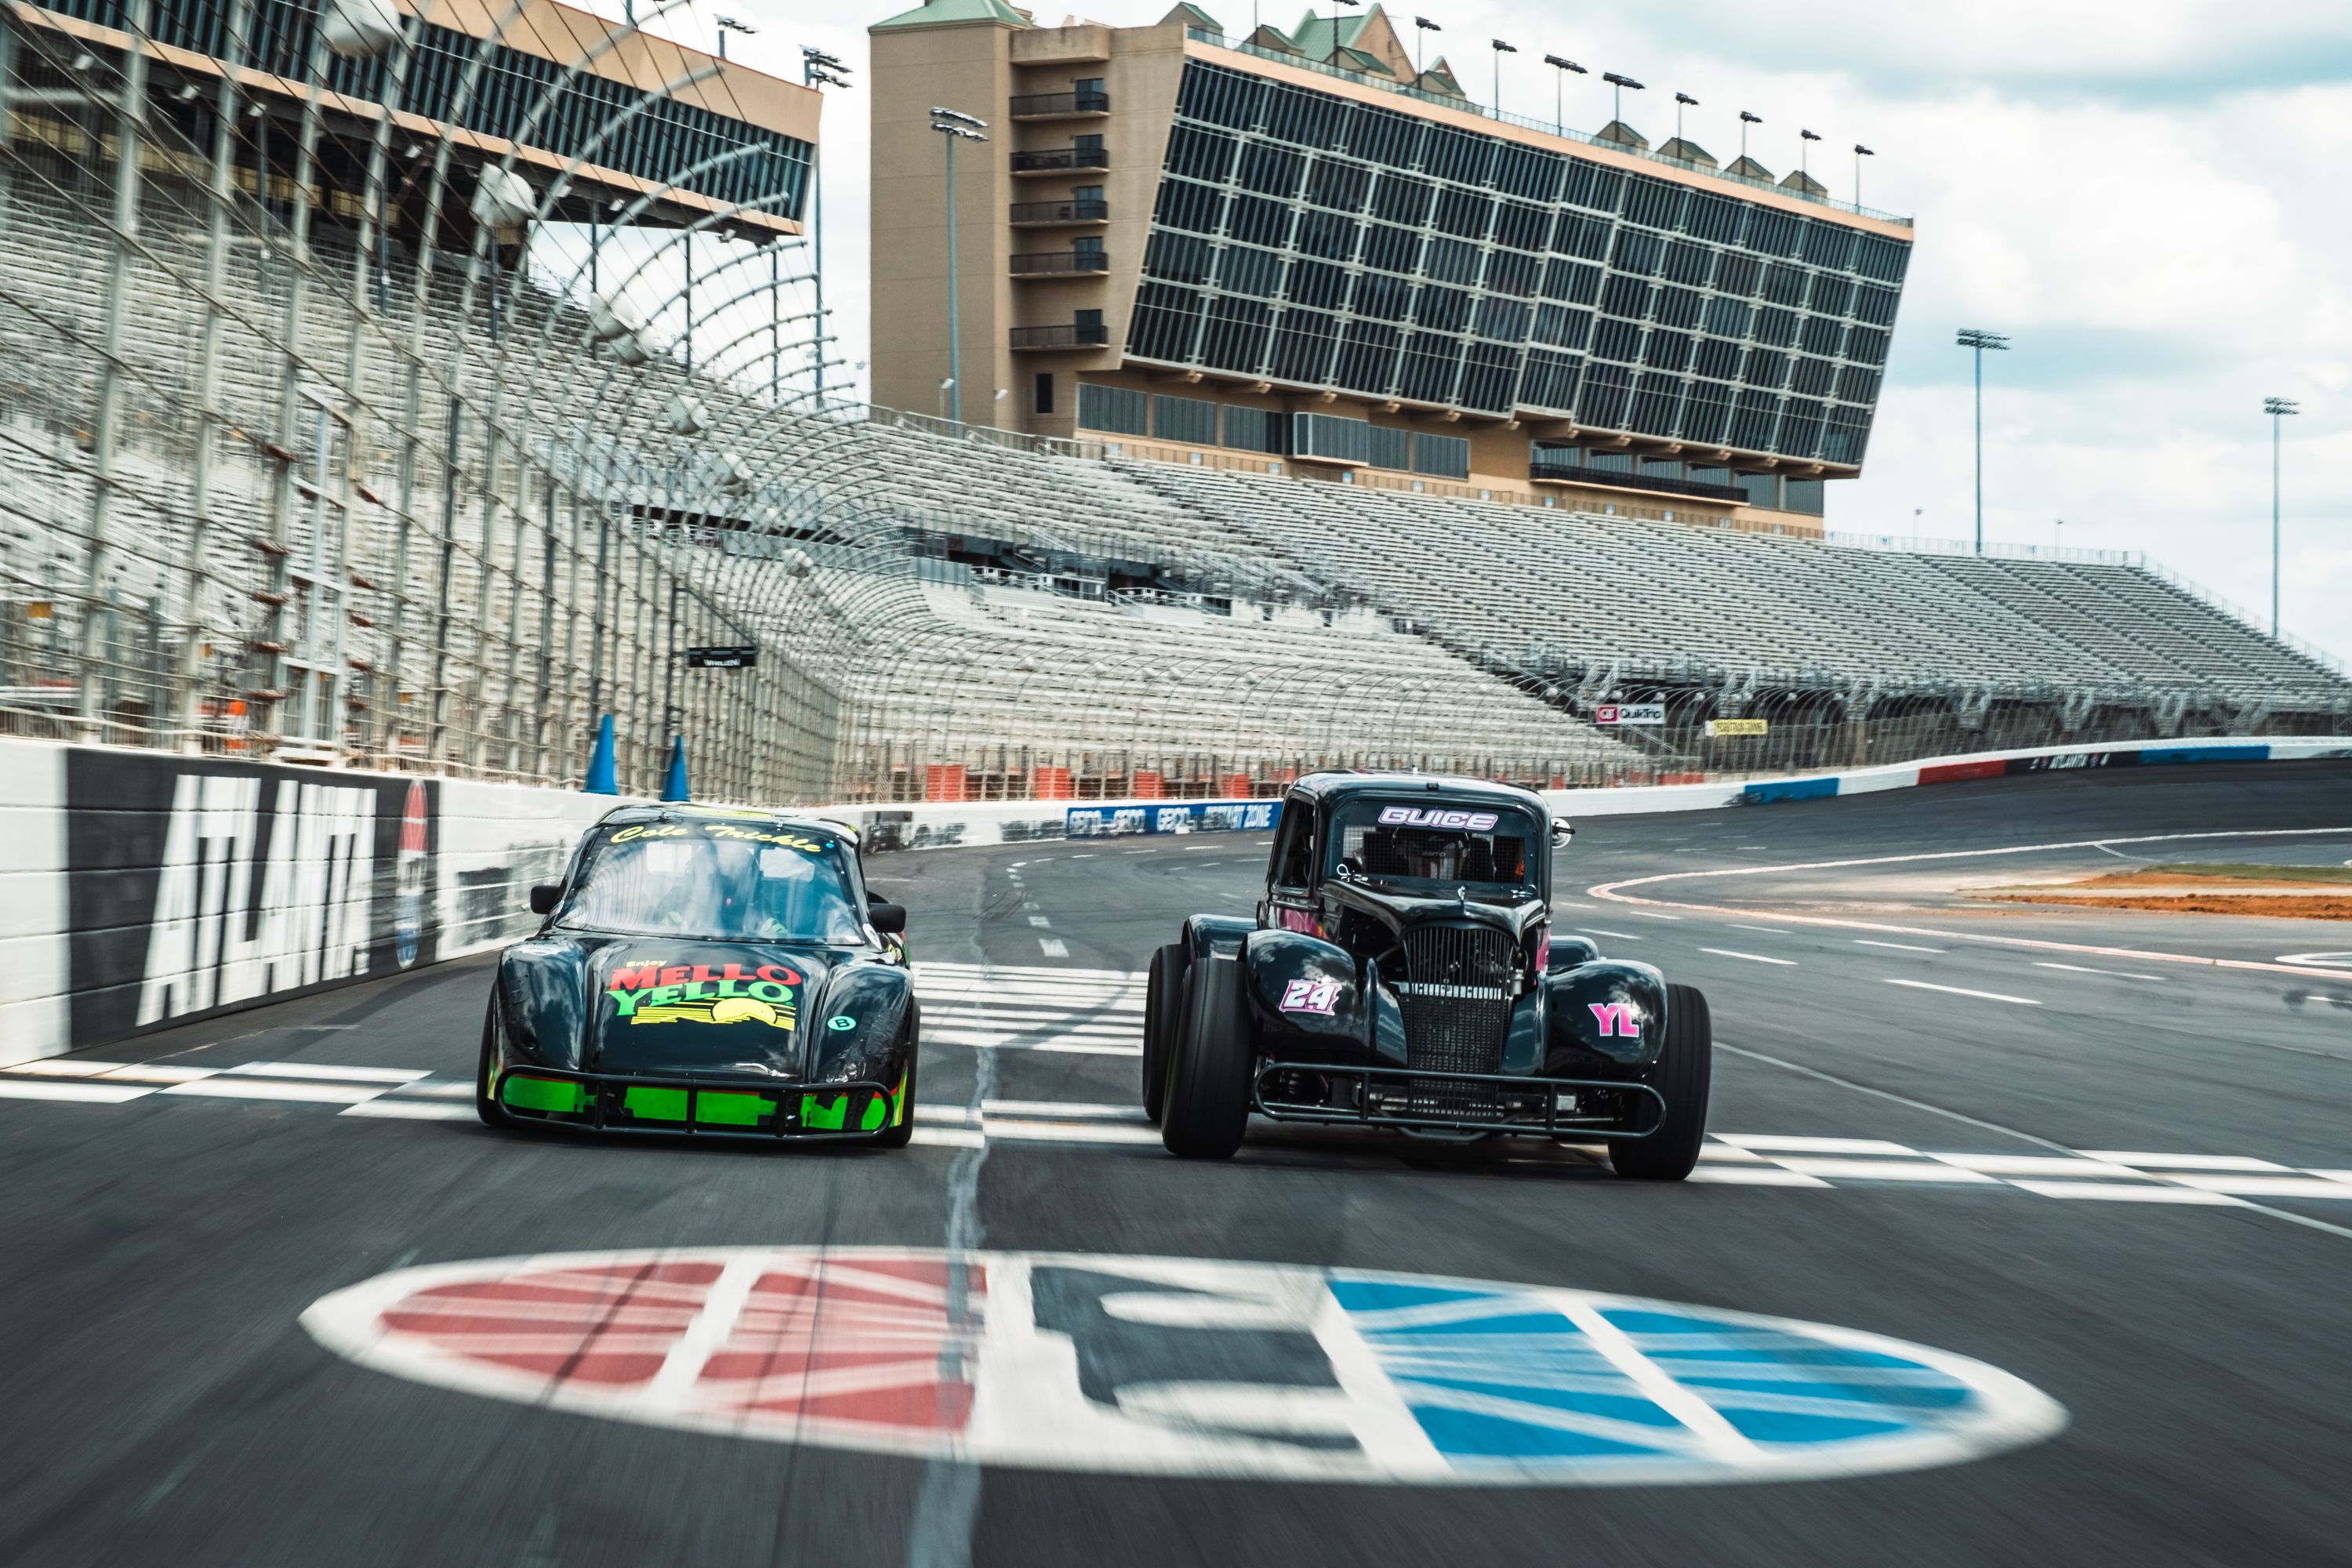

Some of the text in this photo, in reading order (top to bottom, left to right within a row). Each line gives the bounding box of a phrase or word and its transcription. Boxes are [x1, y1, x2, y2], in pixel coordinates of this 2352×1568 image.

[1619, 708, 1662, 720] QuikTrip
[1377, 806, 1498, 831] BUICE
[610, 826, 821, 852] Cole Trickle
[136, 775, 377, 1026] ATLANTA
[626, 959, 668, 967] Enjoy
[608, 964, 801, 991] MELLO
[605, 979, 793, 1016] YELLO
[1280, 980, 1339, 1014] 24
[1588, 1003, 1639, 1037] YL
